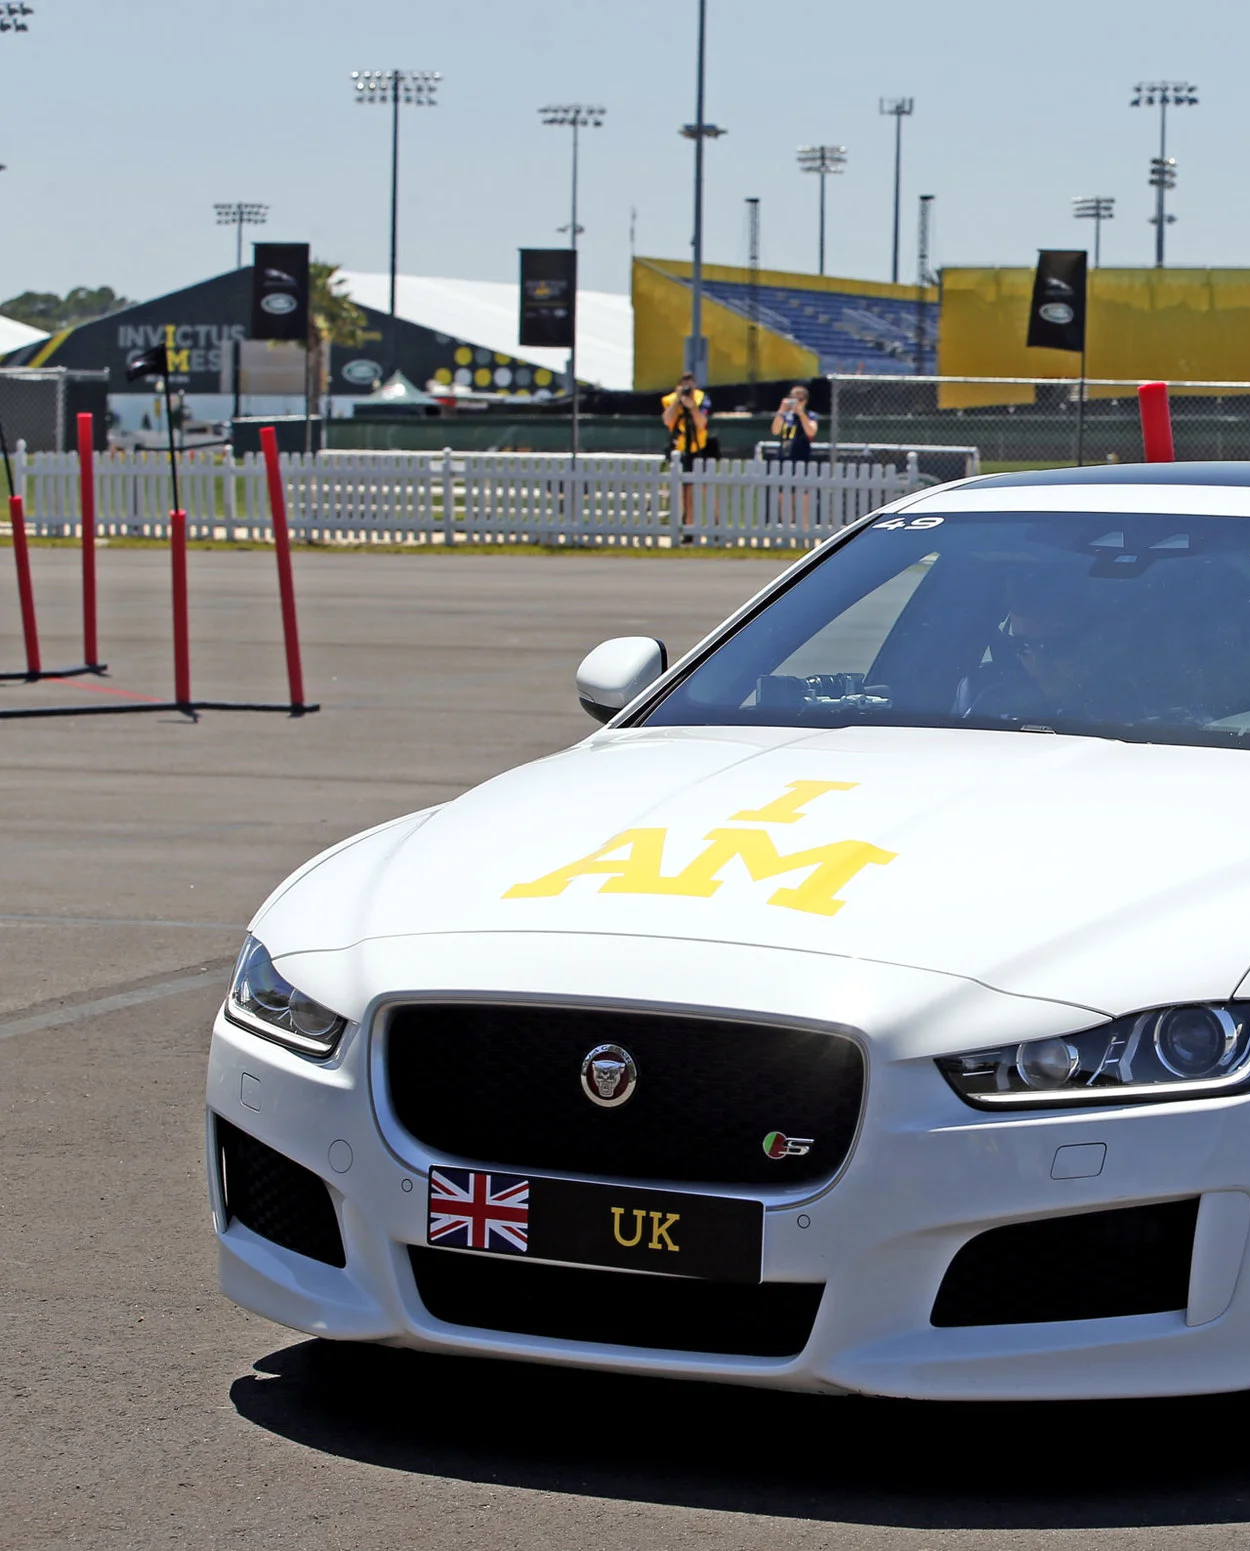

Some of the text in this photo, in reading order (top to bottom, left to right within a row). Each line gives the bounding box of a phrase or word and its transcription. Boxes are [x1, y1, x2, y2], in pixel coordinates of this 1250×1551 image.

[118, 324, 246, 348] INVICTUS
[126, 348, 222, 373] MES
[872, 517, 945, 531] 49
[726, 779, 862, 824] I
[500, 827, 900, 917] AM
[611, 1206, 680, 1252] UK
